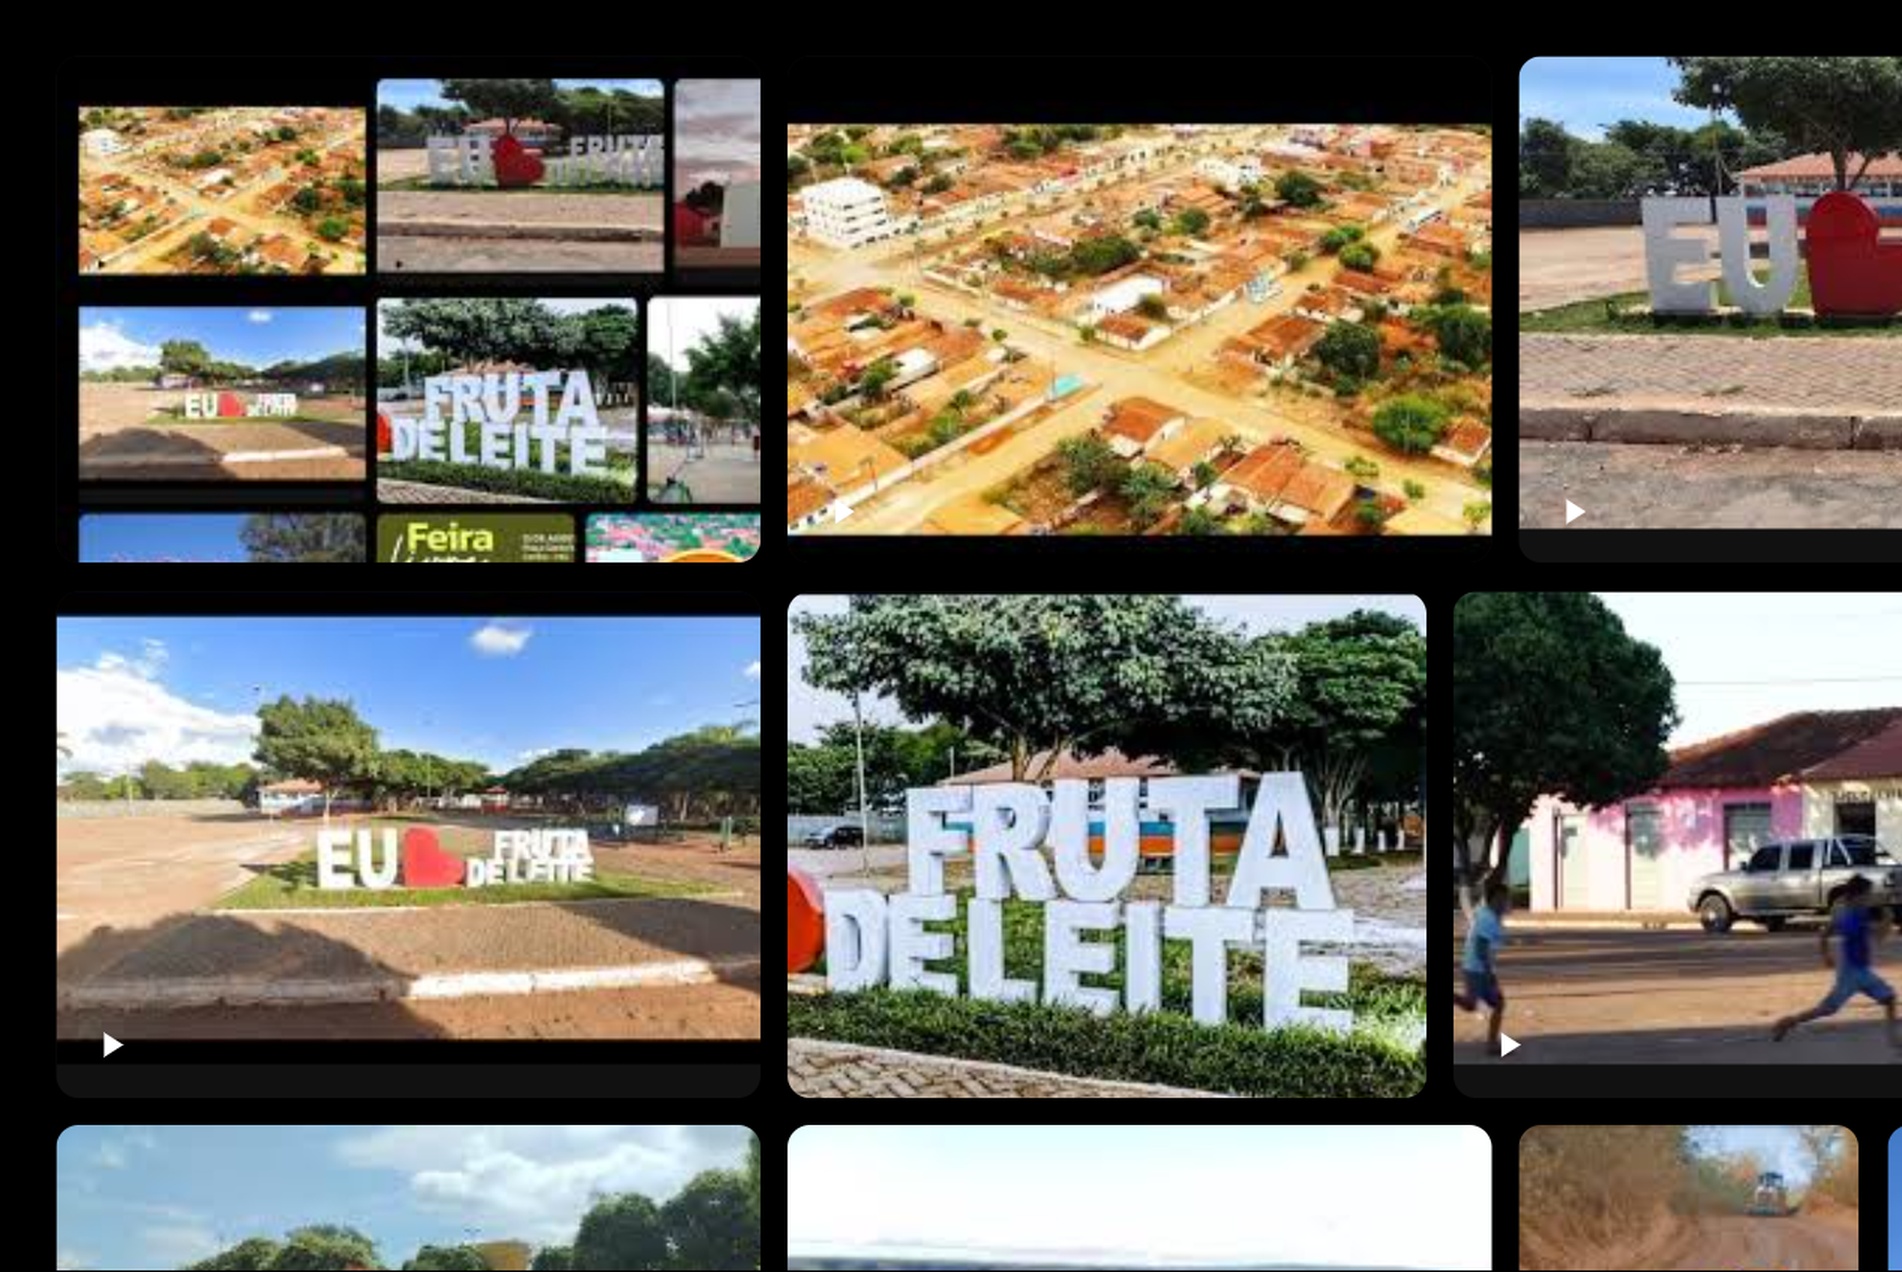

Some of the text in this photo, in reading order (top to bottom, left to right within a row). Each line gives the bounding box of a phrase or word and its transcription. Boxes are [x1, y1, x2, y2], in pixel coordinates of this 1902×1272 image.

[1641, 194, 1799, 313] EU
[184, 392, 218, 418] EU
[424, 369, 600, 427] FRUTA
[407, 522, 494, 551] Feira
[317, 828, 398, 888] EU
[494, 828, 591, 860] FRUTA
[906, 771, 1336, 909] FRUTA
